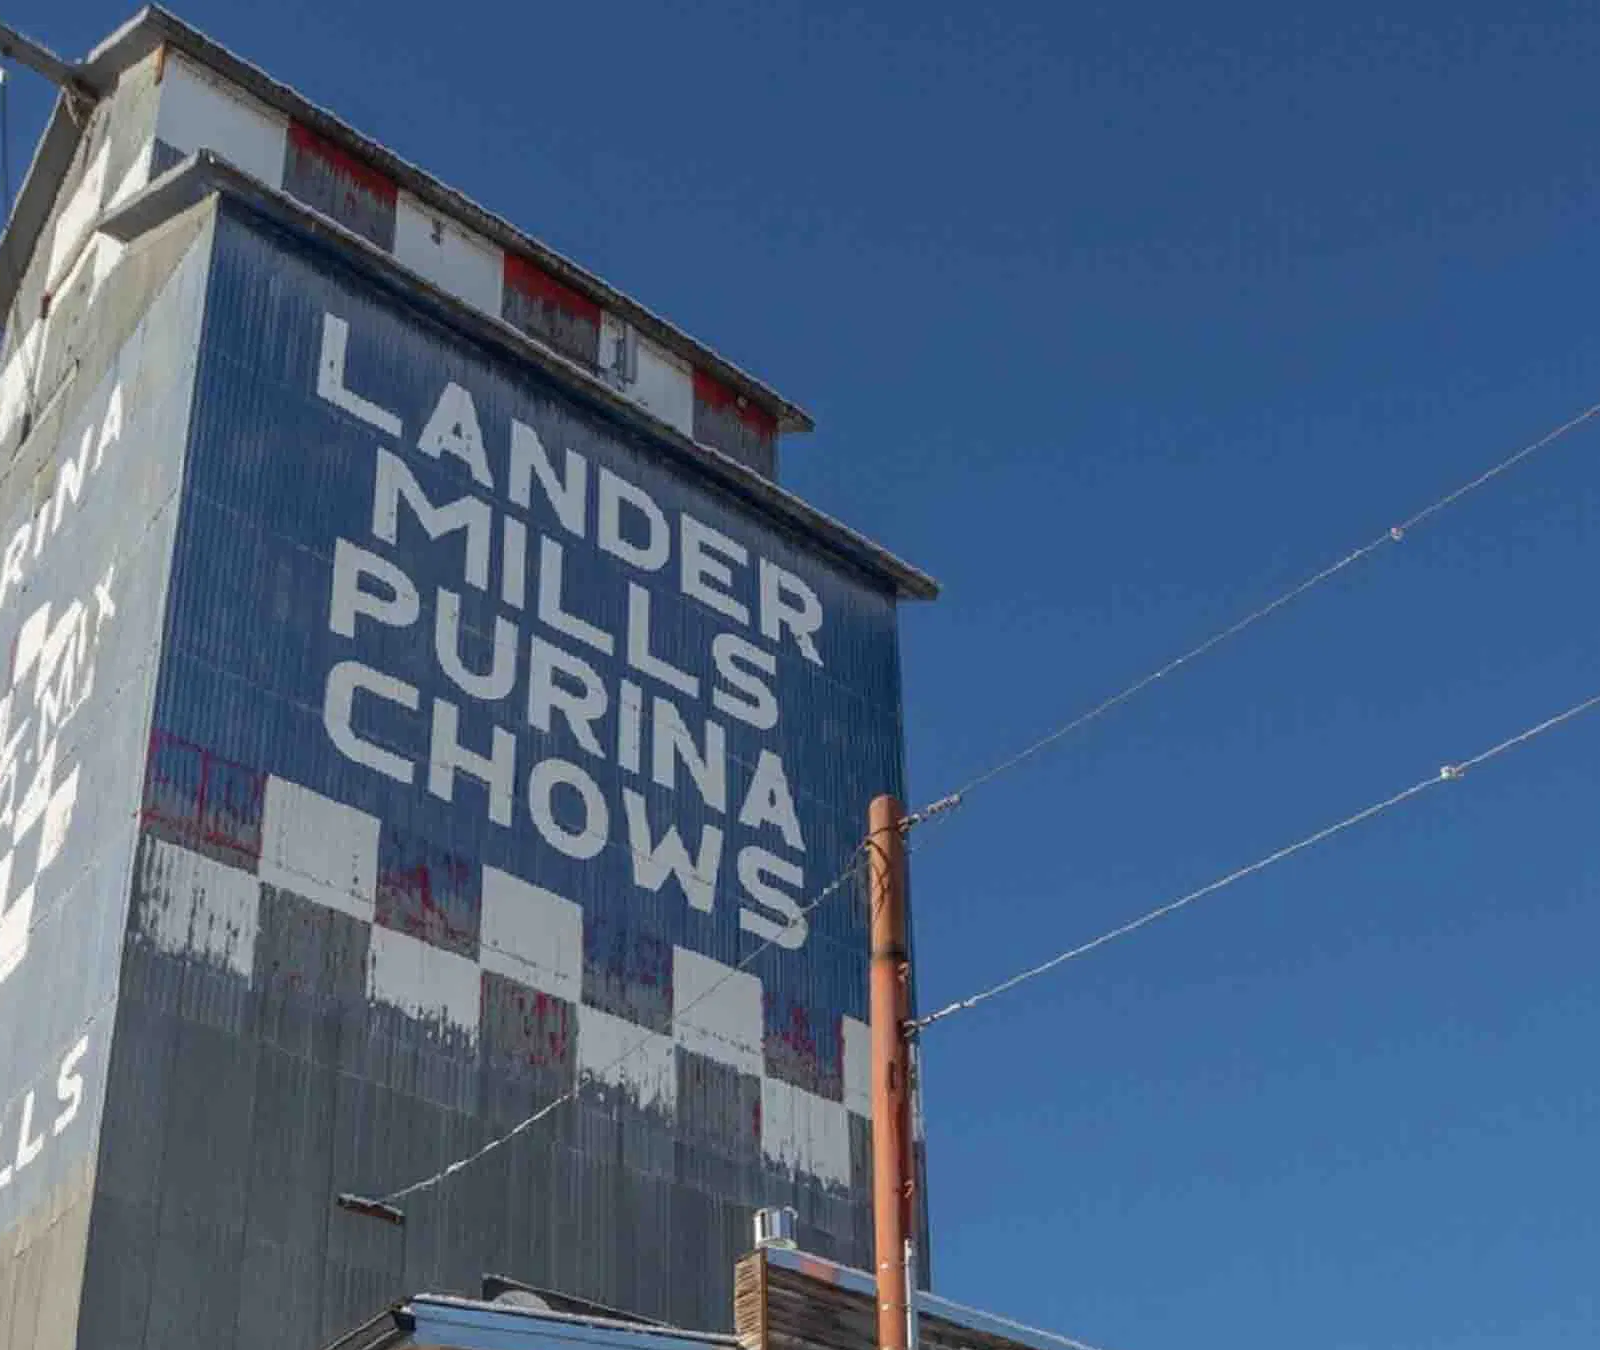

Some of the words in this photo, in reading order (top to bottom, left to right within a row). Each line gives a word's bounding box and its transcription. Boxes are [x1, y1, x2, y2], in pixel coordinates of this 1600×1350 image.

[316, 312, 823, 667] LANDER
[371, 446, 778, 731] MILLS
[323, 660, 809, 951] CHOWS
[329, 536, 807, 853] PURINA
